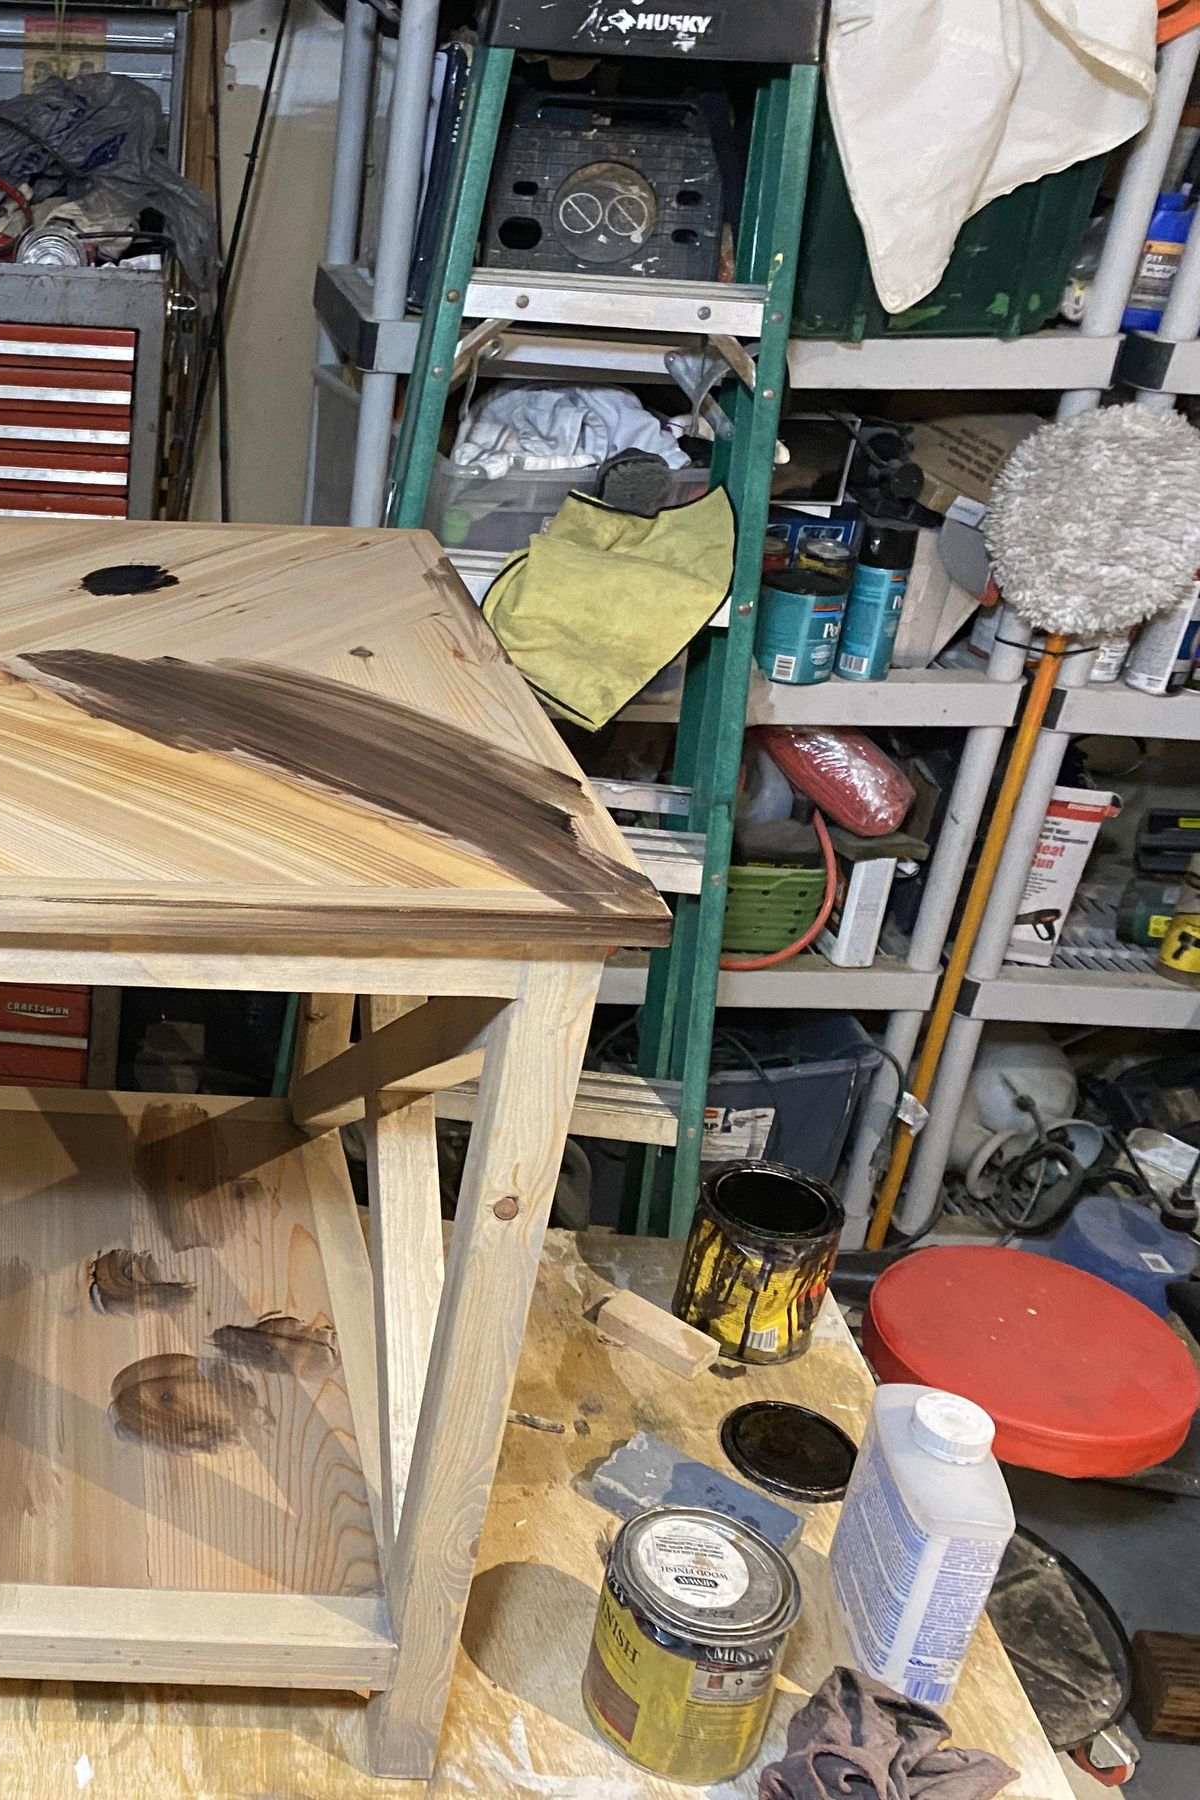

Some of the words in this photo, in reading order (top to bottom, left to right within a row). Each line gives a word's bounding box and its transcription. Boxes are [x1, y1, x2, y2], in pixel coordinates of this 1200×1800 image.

[636, 13, 712, 34] HUSKY
[6, 1002, 70, 1016] CRAFTSMAN
[661, 1565, 695, 1576] FINISH
[696, 1569, 729, 1580] WOOD
[677, 1576, 717, 1588] MINWAX
